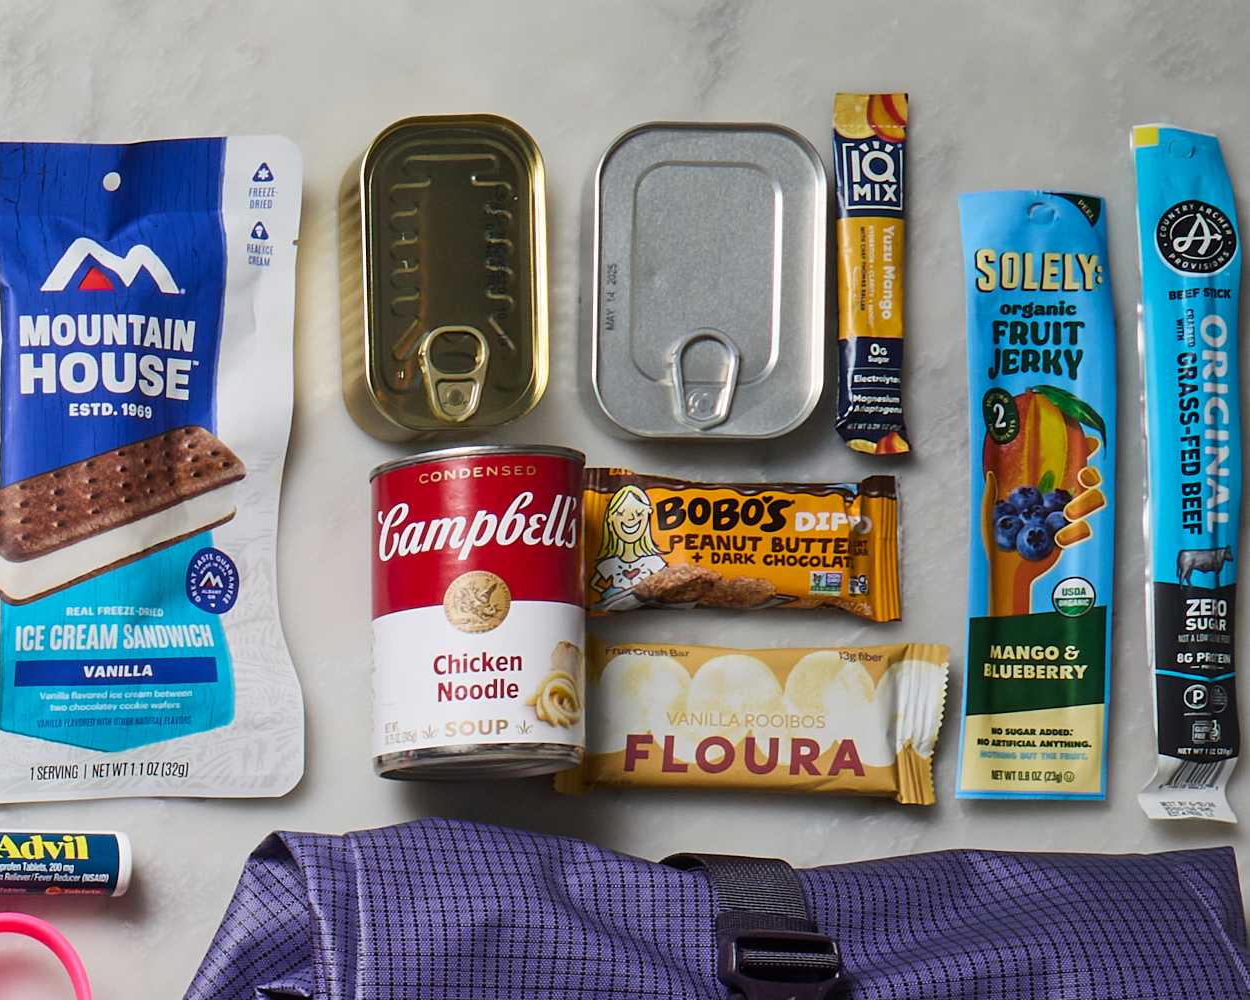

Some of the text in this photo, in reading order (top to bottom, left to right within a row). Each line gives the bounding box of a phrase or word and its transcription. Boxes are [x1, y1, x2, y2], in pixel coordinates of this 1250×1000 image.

[851, 150, 897, 183] IQ
[249, 198, 273, 210] DRIED
[853, 184, 898, 202] MIX
[1159, 203, 1233, 238] COUNTRY ARCHER
[1167, 249, 1230, 273] PROVISIONS
[878, 225, 896, 321] Yuzu Mango
[1168, 287, 1231, 301] BEEF STICK
[999, 301, 1077, 318] organic
[18, 313, 197, 353] MOUNTAIN
[992, 320, 1086, 346] FRUIT
[988, 348, 1085, 381] JERKY
[19, 352, 192, 401] HOUSE
[68, 402, 153, 420] ESTD. 1969
[1200, 314, 1230, 534] ORIGINAL
[1176, 351, 1203, 536] GRASS-FED BEEF
[418, 464, 538, 485] CONDENSED
[655, 495, 792, 533] BOBO'S
[377, 491, 578, 562] Campbell's
[668, 533, 853, 556] PEANUT BUTTE
[1061, 586, 1087, 597] USDA
[65, 605, 165, 618] REAL FREEZE-DRIED
[1185, 598, 1228, 617] ZERO
[1185, 618, 1227, 631] SUGAR
[14, 620, 215, 653] ICE CREAM SANDWICH
[432, 651, 523, 675] Chicken
[857, 651, 883, 664] fiber
[990, 645, 1080, 661] MANGO &
[82, 663, 154, 679] VANILLA
[983, 662, 1088, 681] BLUEBERRY
[437, 678, 519, 702] Noodle
[445, 718, 510, 738] SOUP
[666, 711, 827, 730] VANILLA ROOIBOS
[623, 733, 866, 778] FLOURA
